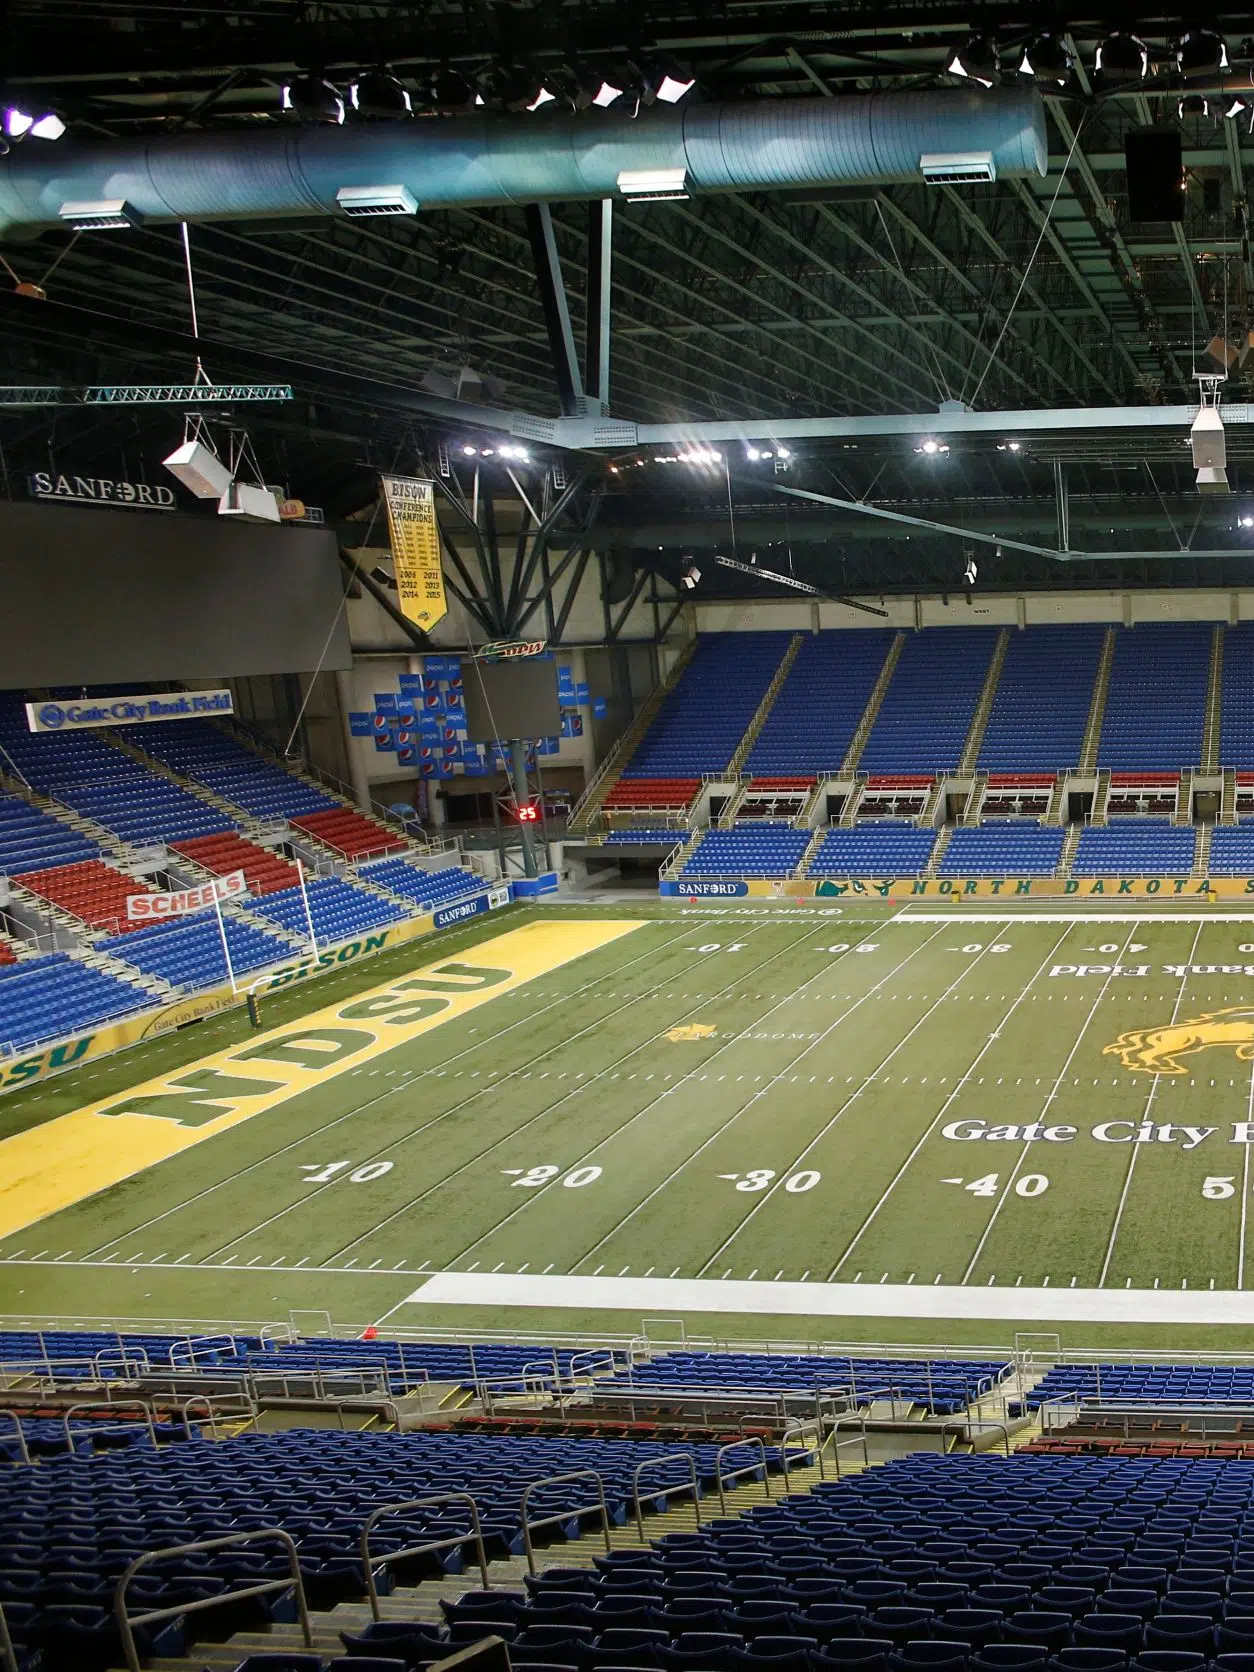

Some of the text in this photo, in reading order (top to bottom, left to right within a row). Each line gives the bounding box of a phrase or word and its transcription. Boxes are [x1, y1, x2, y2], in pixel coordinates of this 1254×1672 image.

[35, 472, 173, 505] SANFORD
[392, 482, 427, 500] BISON
[392, 511, 433, 523] CHAMPIONS
[66, 706, 109, 723] Gate
[111, 701, 148, 721] City
[519, 806, 536, 820] 25
[131, 874, 242, 915] SCHEELS
[679, 883, 738, 895] SANFORD
[911, 880, 1033, 895] NORTH
[1064, 879, 1211, 895] DAKOTA
[438, 902, 477, 925] SANFORD
[267, 930, 390, 990] BISON
[1048, 965, 1151, 977] Field
[193, 1004, 216, 1018] Bank
[93, 961, 516, 1130] NDSU
[0, 1035, 97, 1087] SU
[939, 1117, 1080, 1144] Gate
[1089, 1119, 1219, 1150] City
[301, 1160, 395, 1184] 10
[510, 1164, 603, 1188] 20
[735, 1169, 822, 1193] 30
[964, 1173, 1050, 1197] 40
